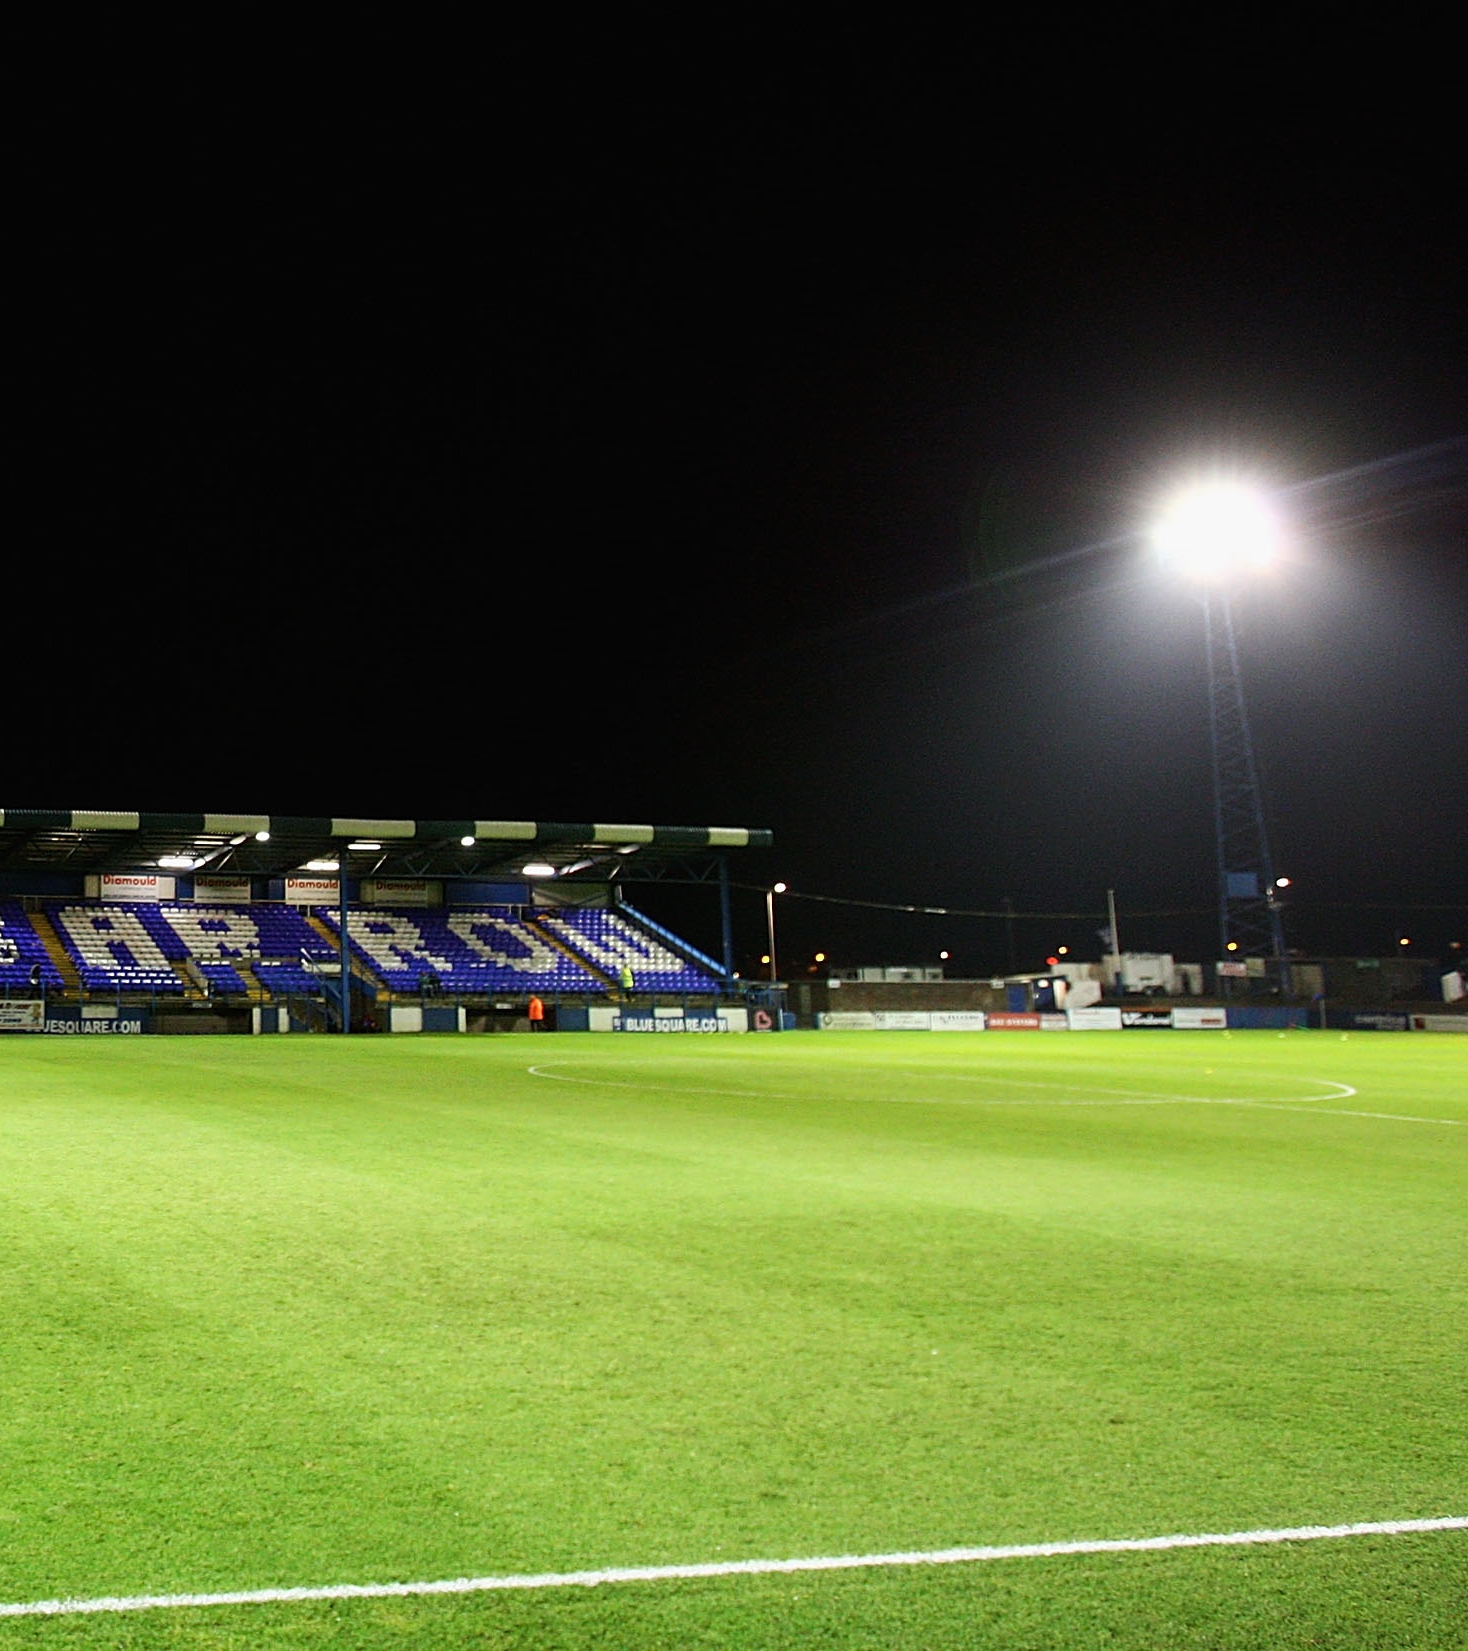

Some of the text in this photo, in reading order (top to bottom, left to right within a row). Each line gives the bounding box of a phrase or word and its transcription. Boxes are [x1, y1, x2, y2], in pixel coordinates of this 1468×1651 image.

[103, 875, 157, 886] Diamould
[196, 877, 249, 888] Diamould
[287, 878, 339, 890] Diamould
[376, 880, 427, 891] Diamould
